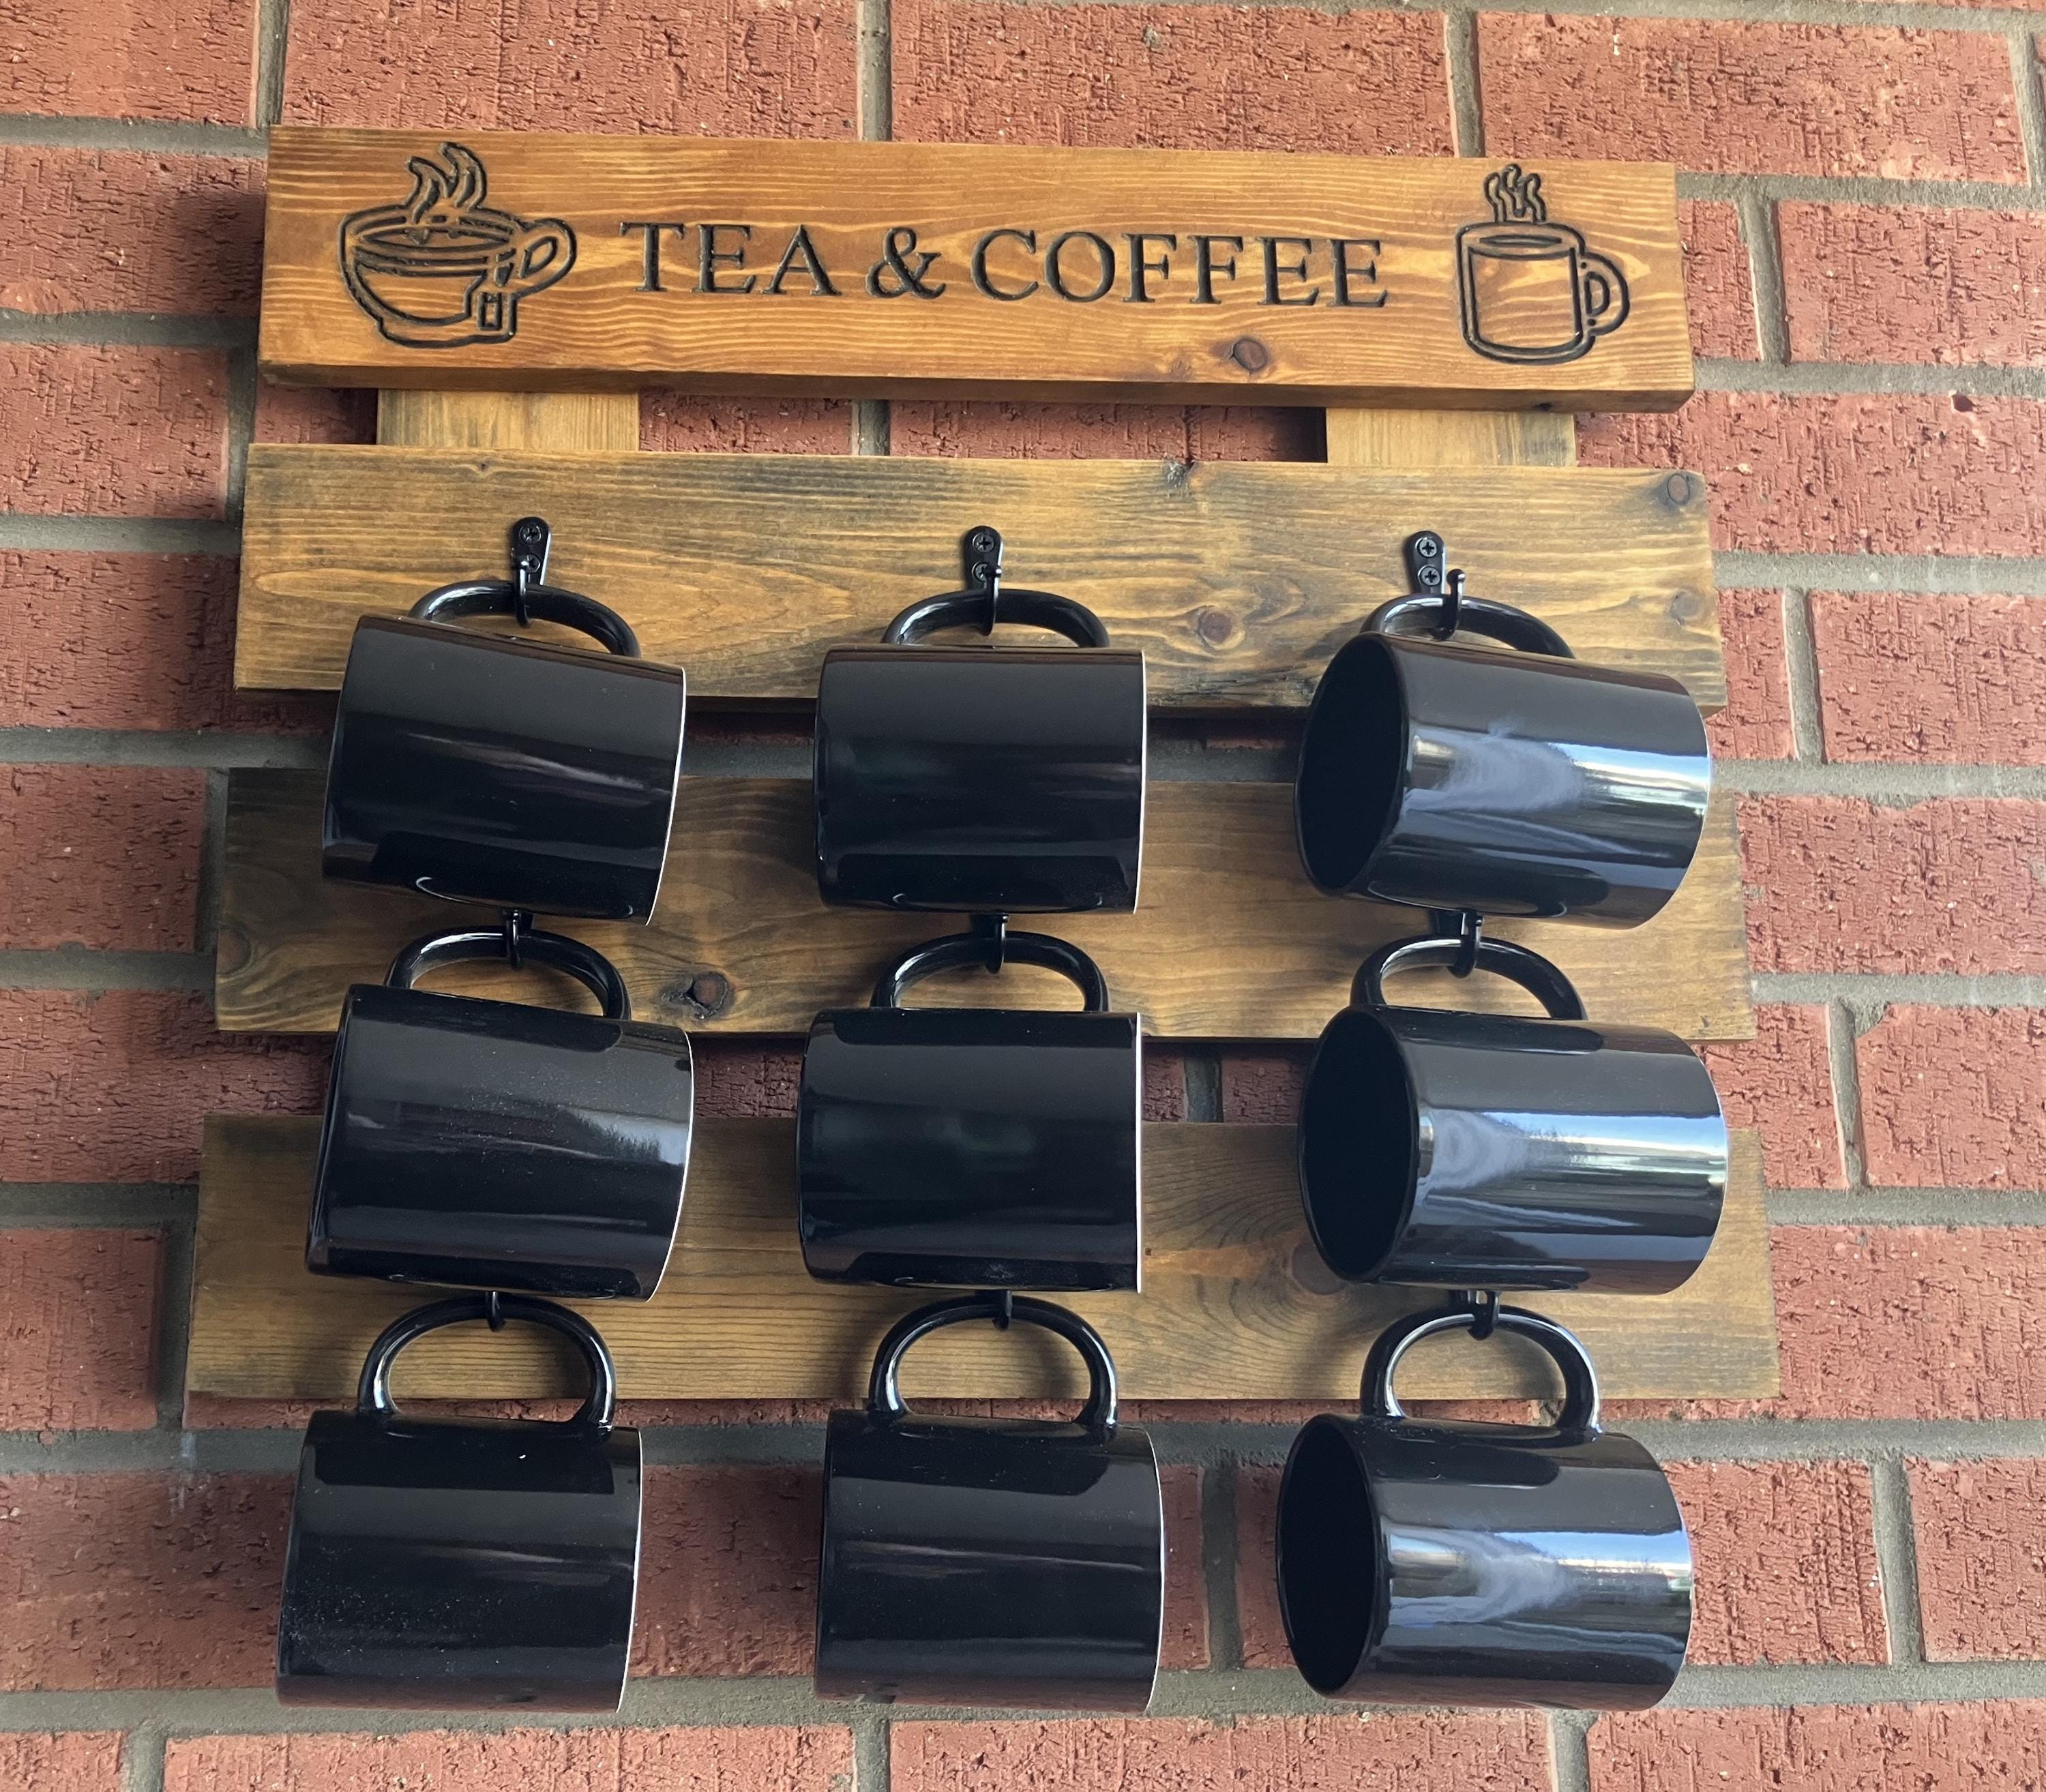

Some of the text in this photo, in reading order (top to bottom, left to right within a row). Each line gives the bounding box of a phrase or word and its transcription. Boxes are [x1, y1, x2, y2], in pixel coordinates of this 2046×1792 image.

[619, 222, 1388, 308] TEA & COFFEE
